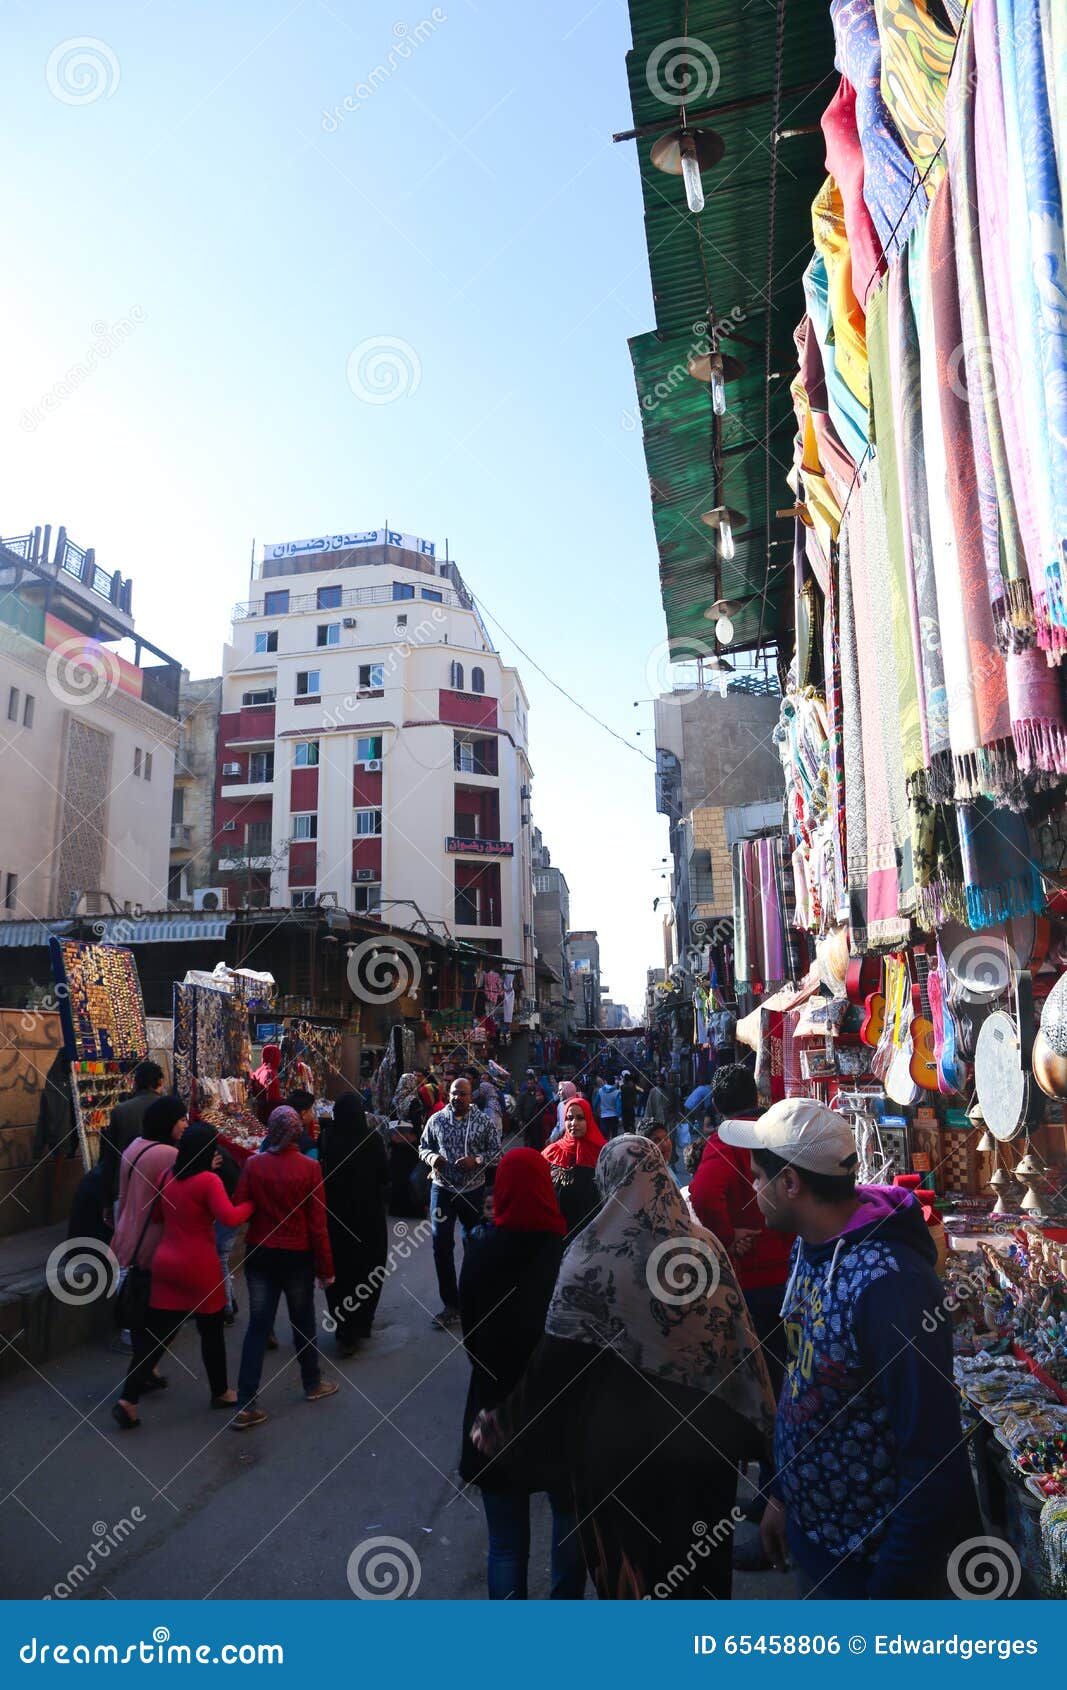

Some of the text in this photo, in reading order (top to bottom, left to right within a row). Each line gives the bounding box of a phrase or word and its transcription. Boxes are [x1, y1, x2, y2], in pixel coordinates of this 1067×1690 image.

[272, 530, 378, 558] فندق رضوان
[388, 531, 435, 556] R H
